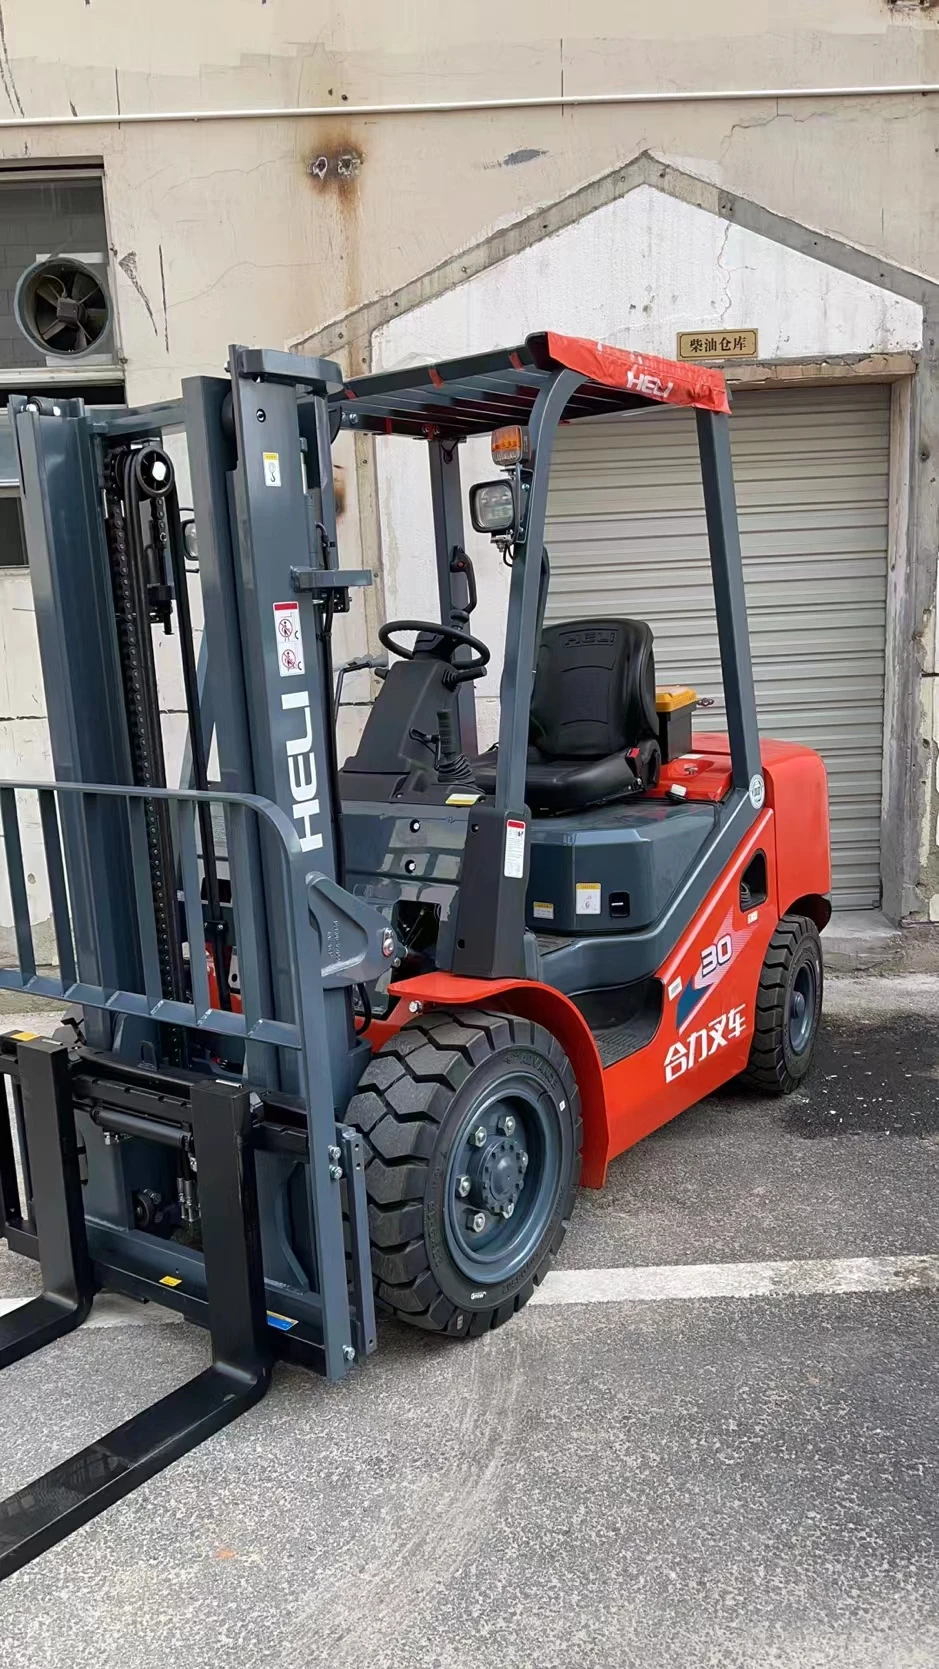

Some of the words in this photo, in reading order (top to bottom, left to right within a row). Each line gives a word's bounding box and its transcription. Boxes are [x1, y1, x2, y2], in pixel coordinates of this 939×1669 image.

[690, 336, 747, 353] 柴油仓库
[280, 690, 324, 853] HELI
[700, 933, 733, 979] 30
[663, 1003, 747, 1084] 合力叉车
